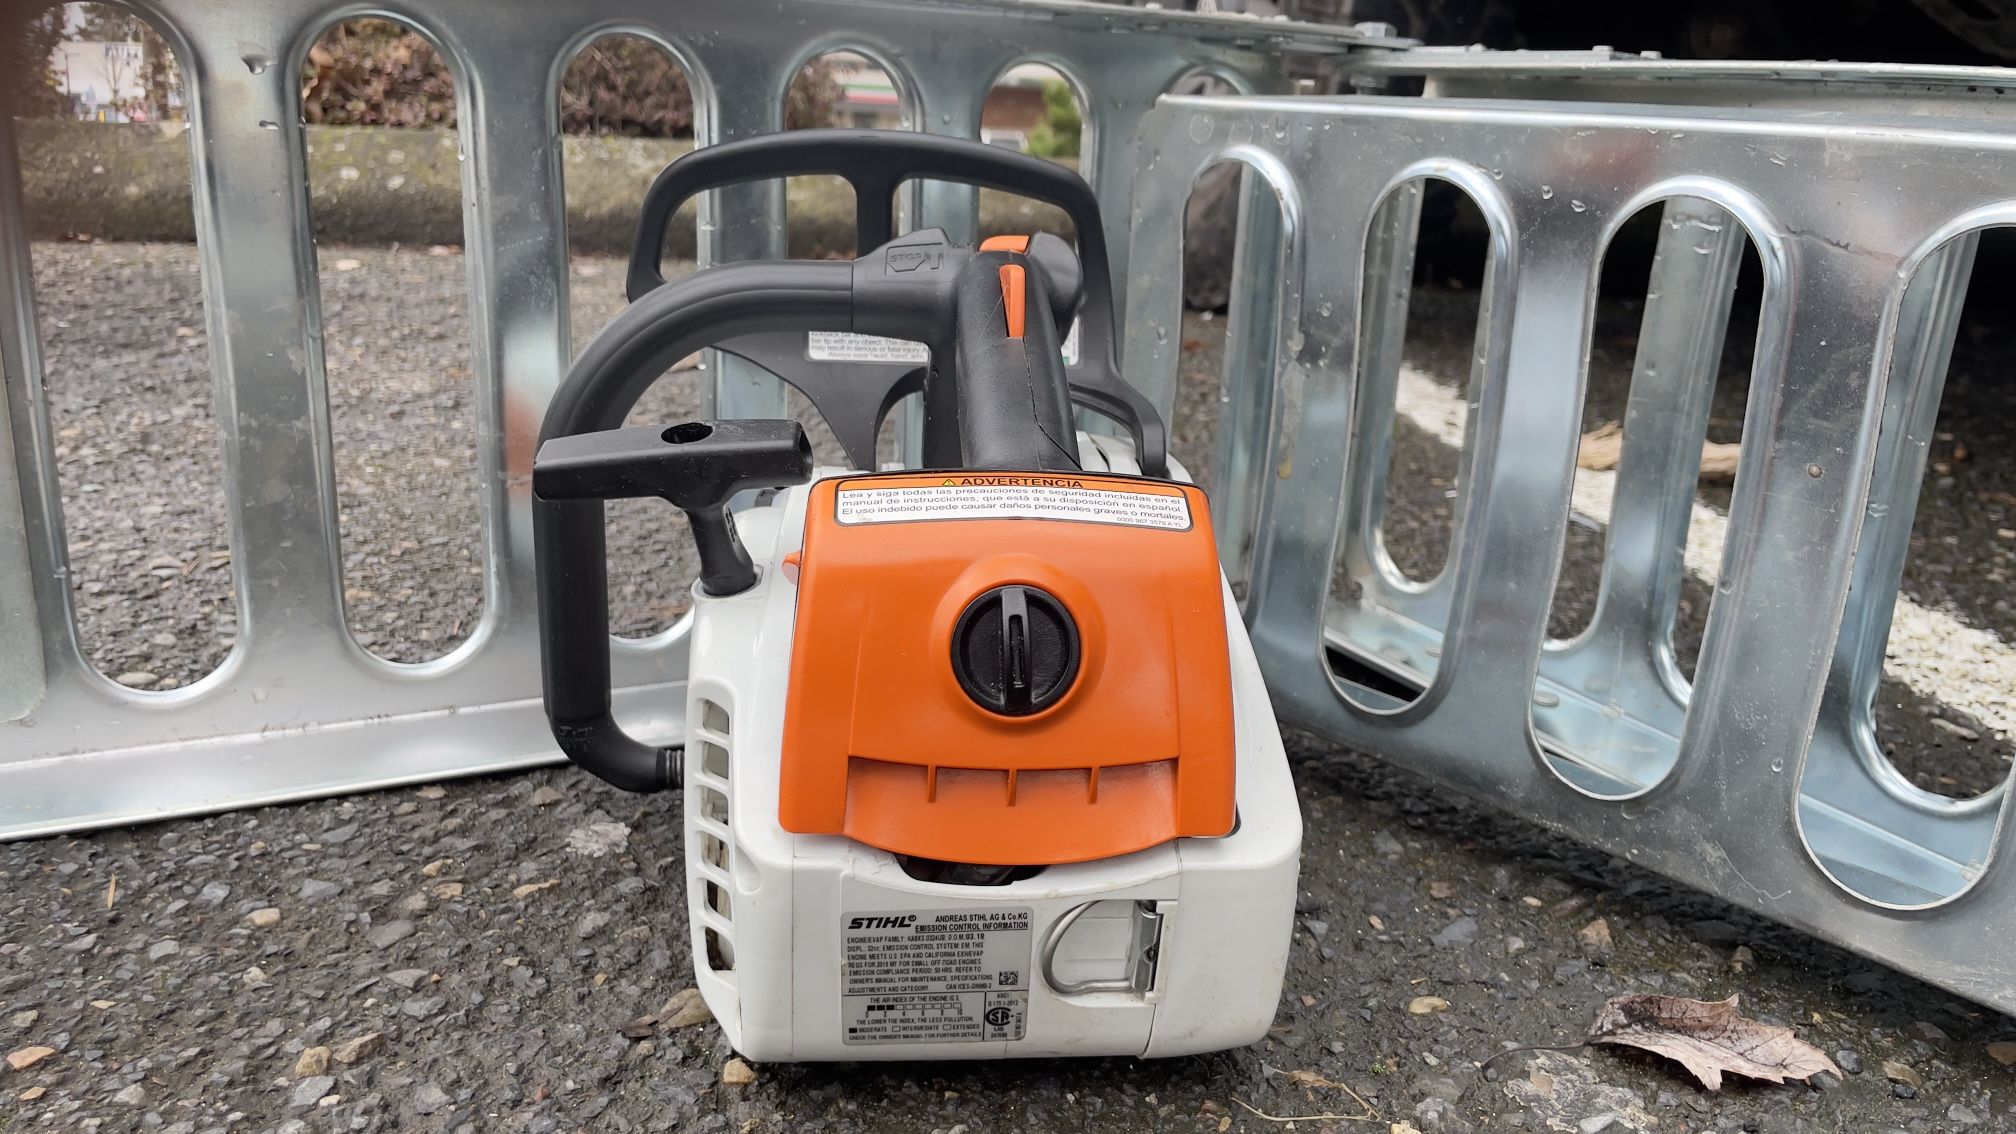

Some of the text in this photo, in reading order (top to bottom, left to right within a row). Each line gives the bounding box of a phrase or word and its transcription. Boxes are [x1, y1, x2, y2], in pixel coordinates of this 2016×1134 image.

[961, 478, 1084, 488] ADVERTENCIA
[1049, 490, 1101, 498] seguridad
[1105, 494, 1151, 502] incluidas
[1060, 498, 1119, 507] disposición
[1035, 504, 1091, 512] personales
[1140, 512, 1186, 522] mortales.
[915, 924, 948, 932] EMISSION
[982, 922, 1028, 930] INFORMATION
[847, 953, 867, 961] ENGINE
[925, 950, 956, 958] CALIFORNIA
